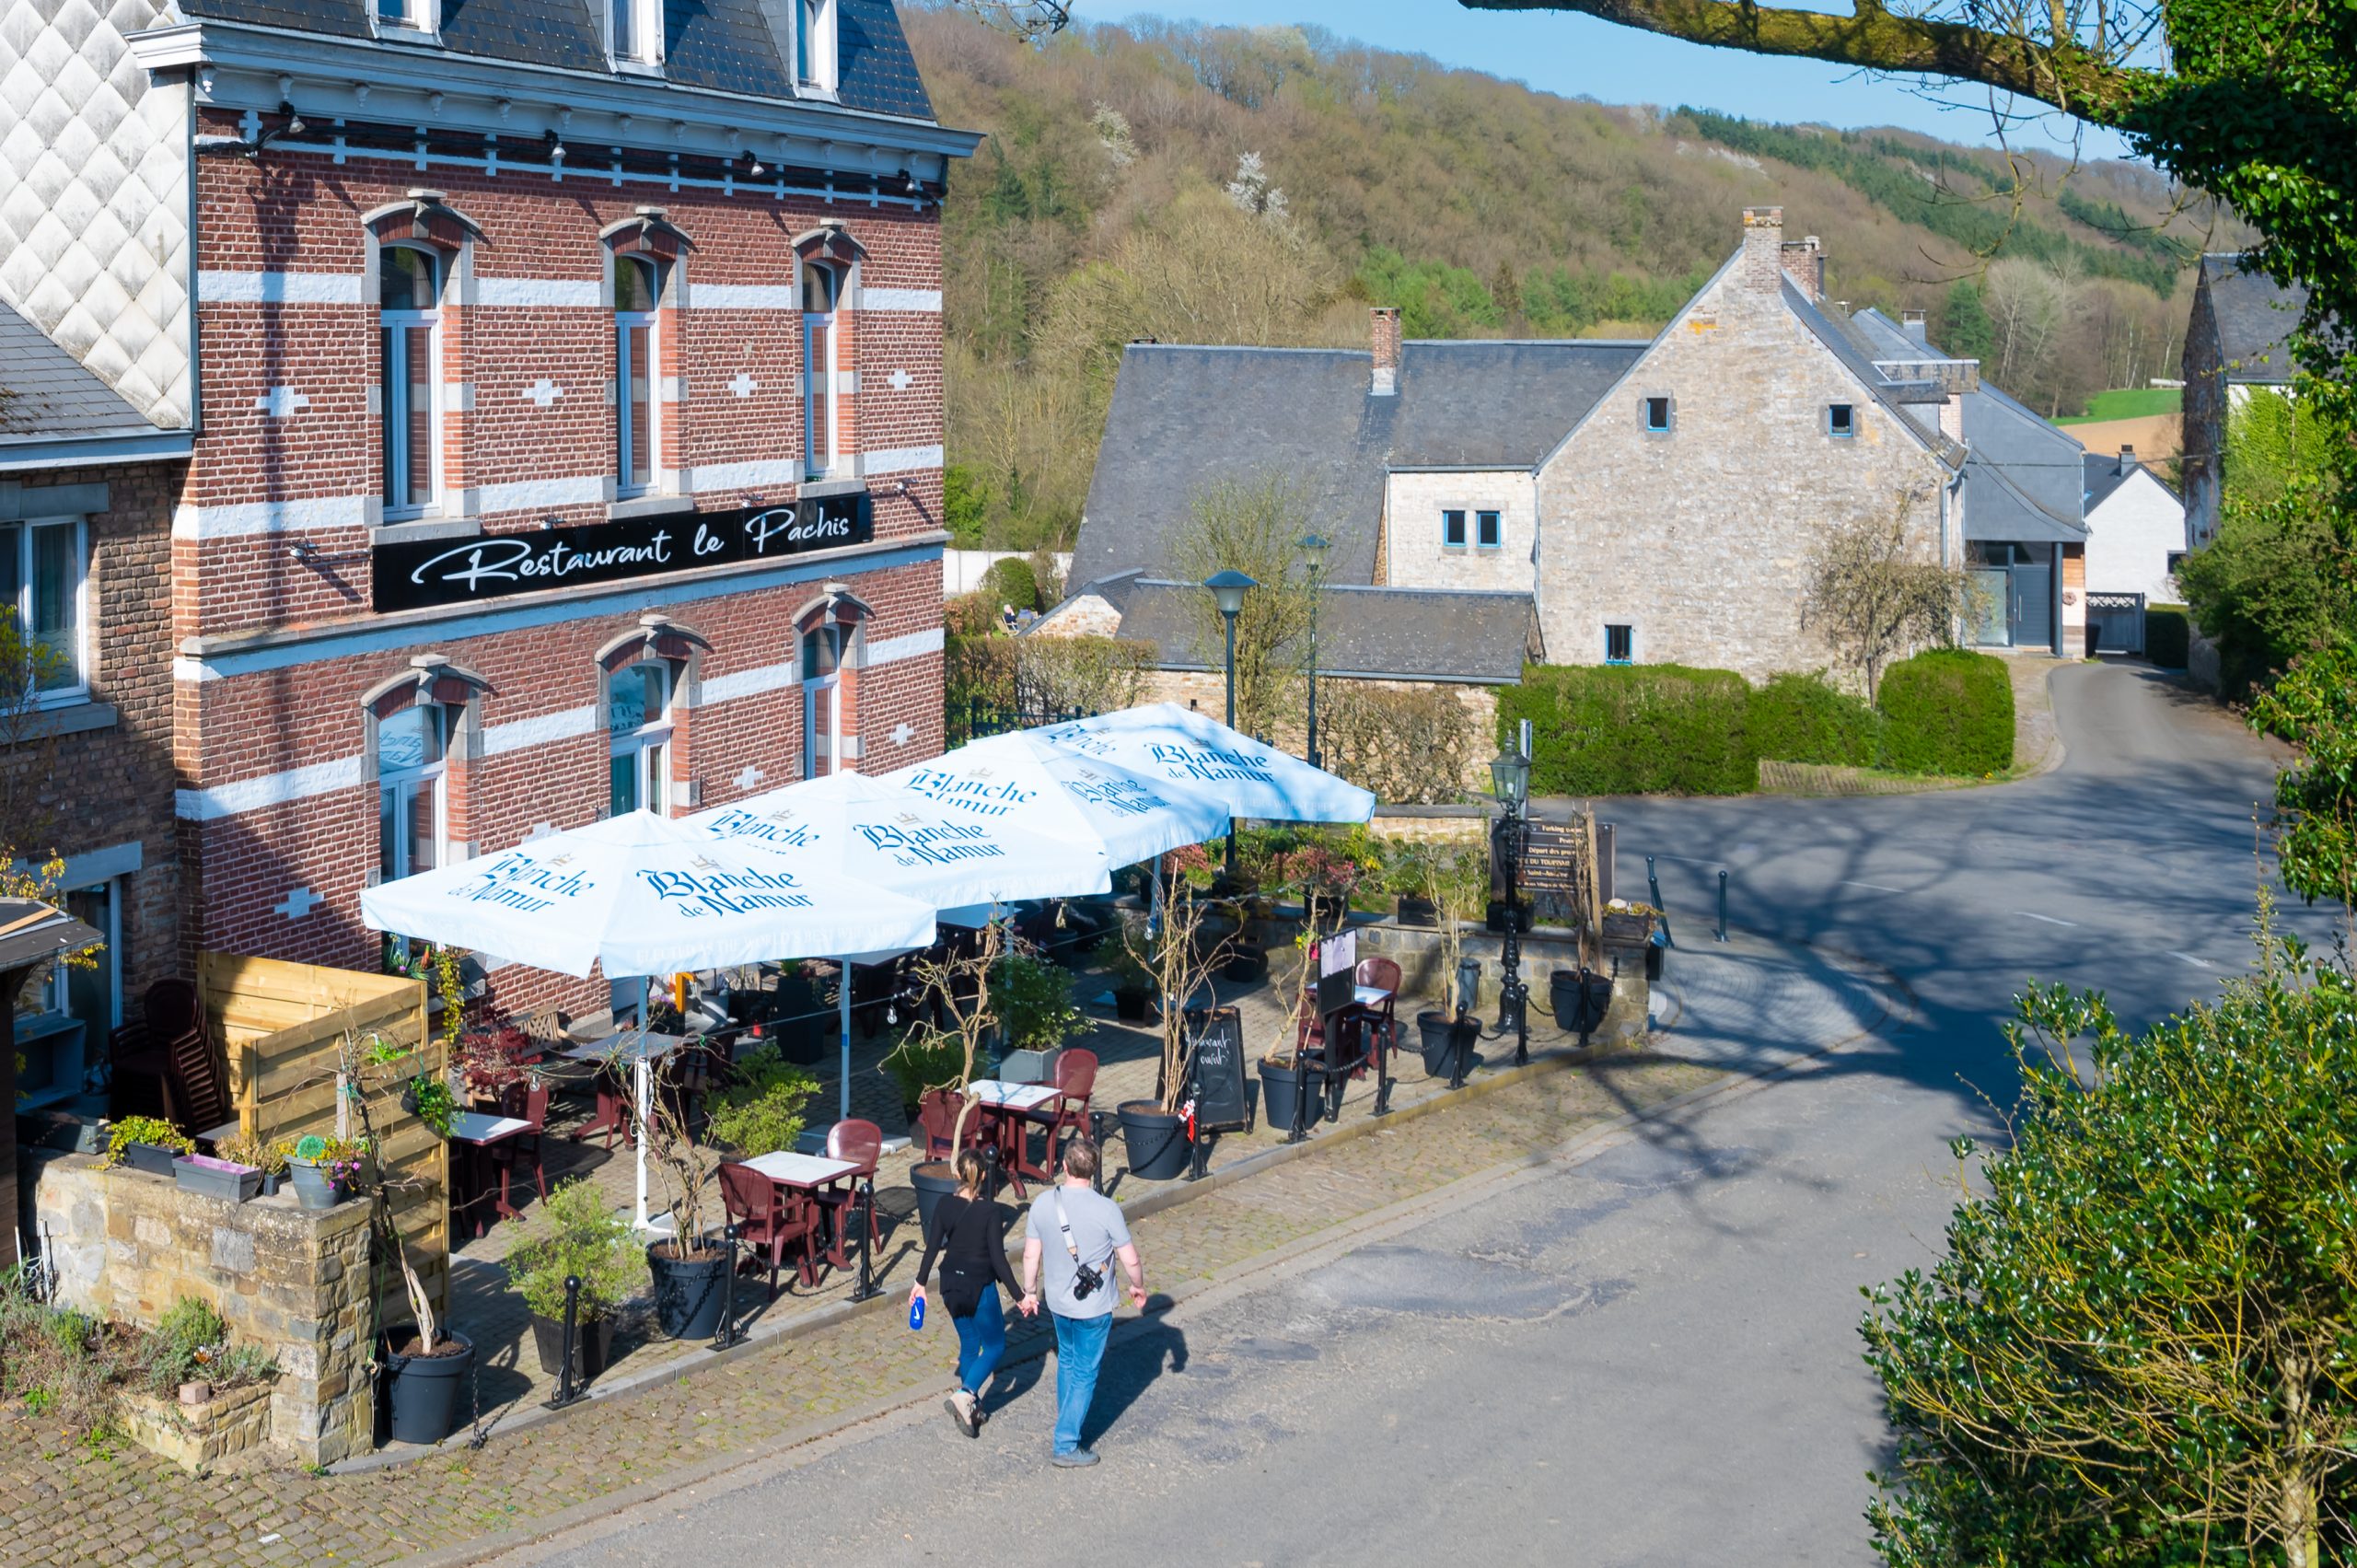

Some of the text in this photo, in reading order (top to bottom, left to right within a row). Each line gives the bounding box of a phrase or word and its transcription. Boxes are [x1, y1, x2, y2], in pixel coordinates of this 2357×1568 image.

[412, 507, 849, 591] Restaurant le Pachis
[1144, 743, 1271, 768] Blanche
[902, 769, 1037, 803] Blanche
[1167, 762, 1274, 783] de Namur
[707, 809, 819, 847] Blanche
[853, 819, 992, 852] Blanche
[893, 842, 1005, 866] de Namur
[480, 853, 595, 897] Blanche
[636, 867, 803, 900] Blanche
[465, 880, 555, 912] Namur
[678, 890, 814, 918] de Namur
